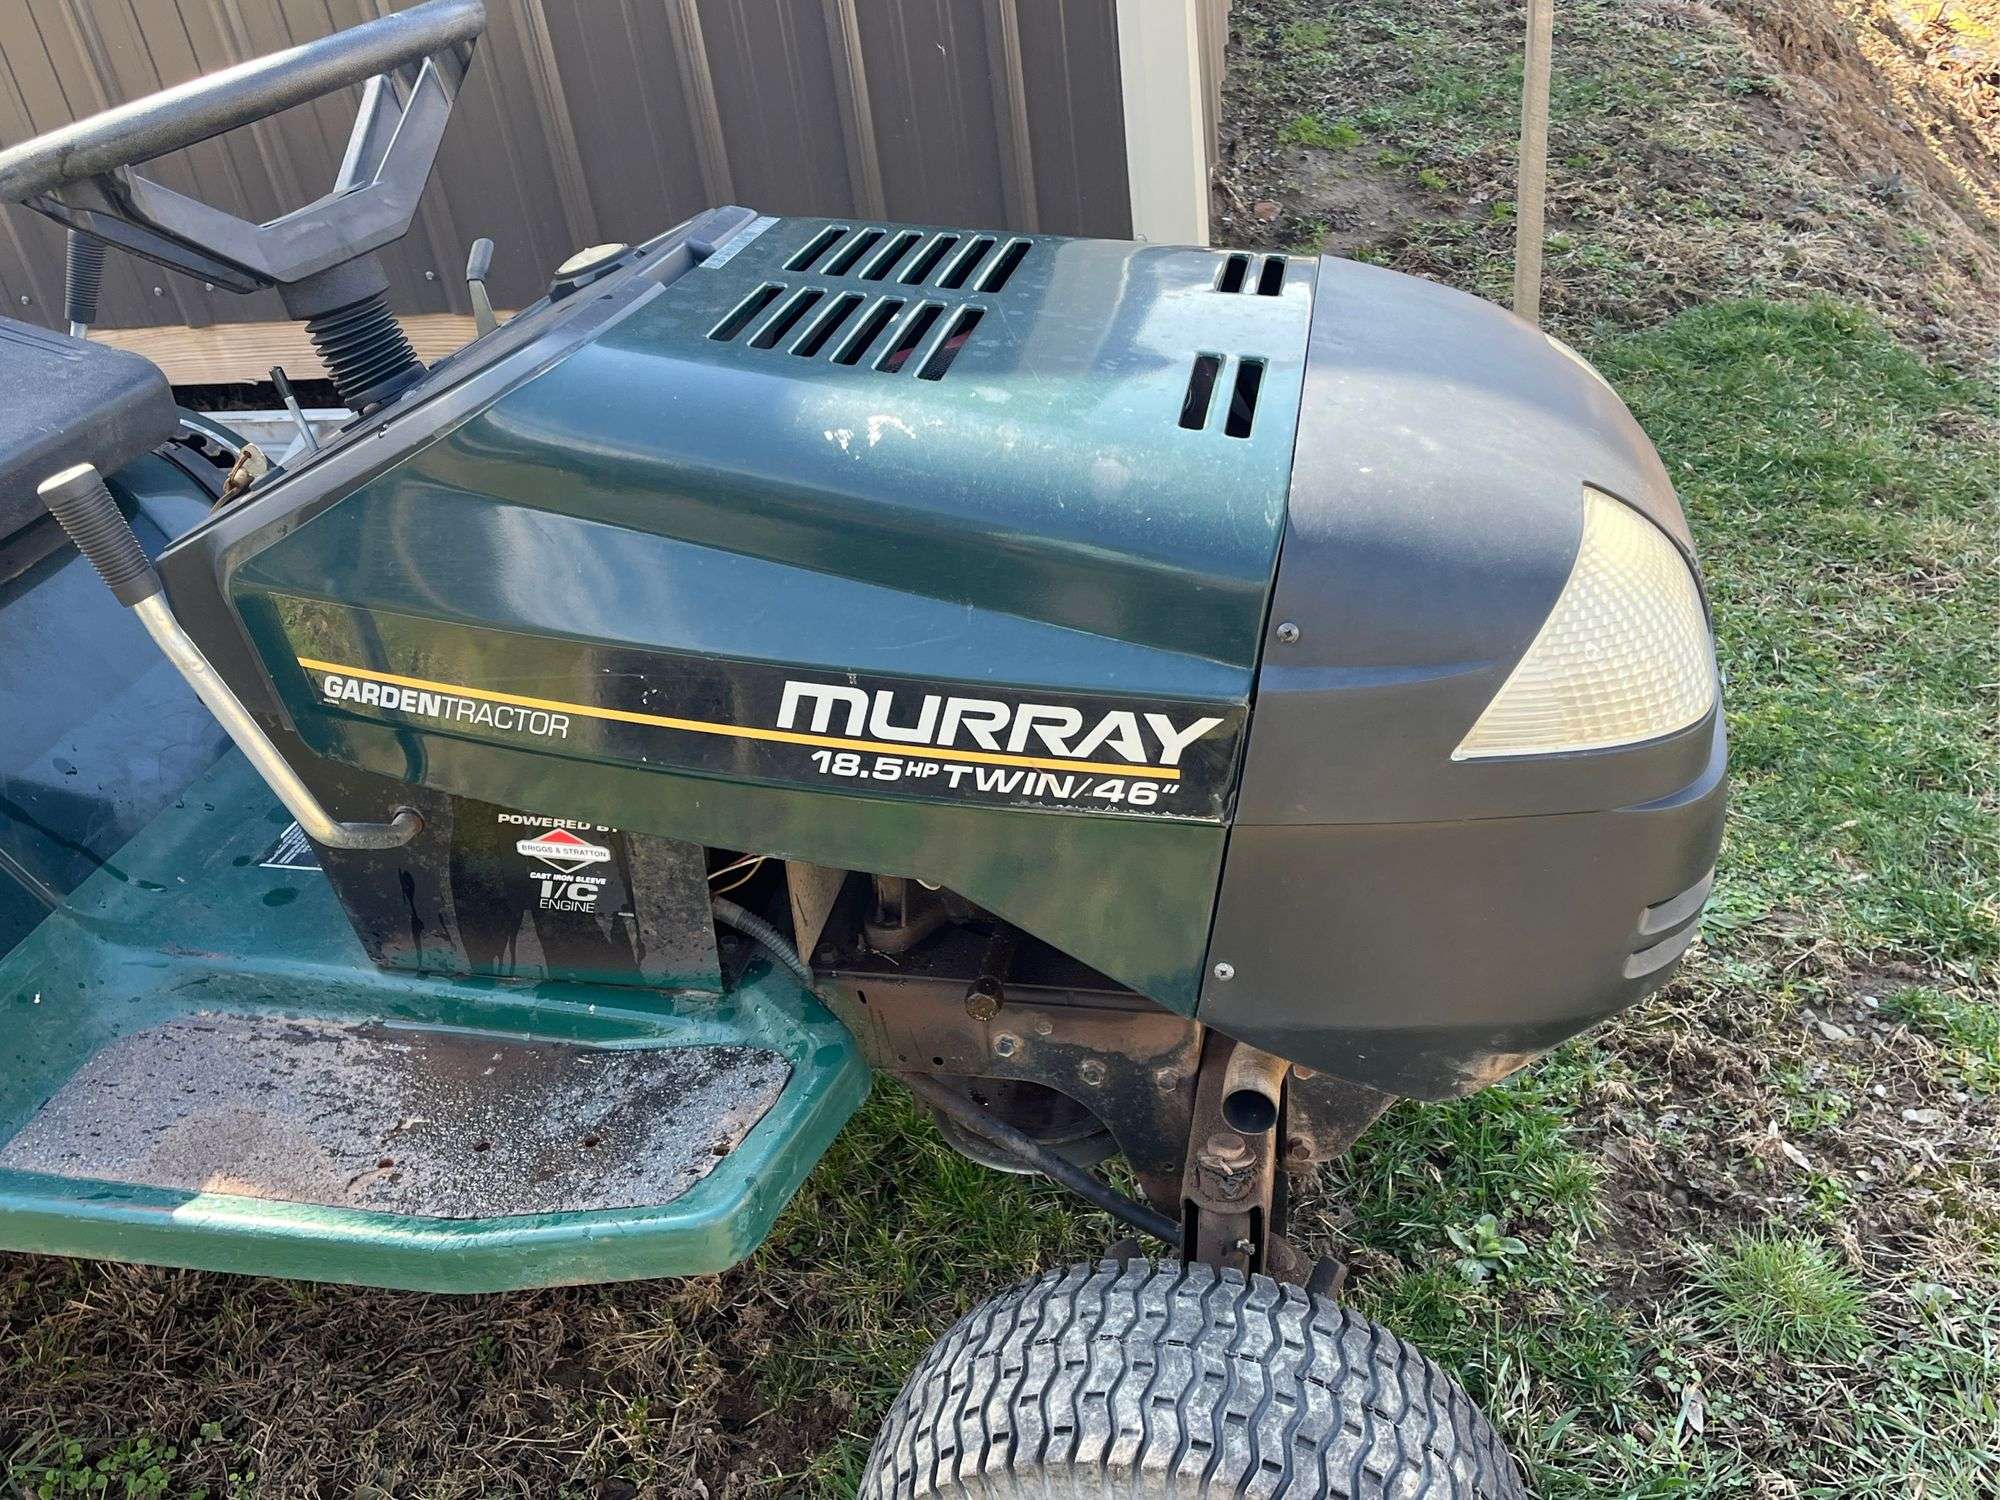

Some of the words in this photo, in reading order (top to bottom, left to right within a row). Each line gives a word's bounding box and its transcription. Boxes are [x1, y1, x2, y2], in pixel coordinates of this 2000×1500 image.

[776, 680, 1224, 765] MURRAY
[498, 813, 591, 831] POWERED
[521, 844, 554, 854] BRIGGS
[562, 847, 607, 858] STRATTON
[529, 872, 552, 880] CAST
[552, 874, 574, 882] IRON
[575, 876, 607, 885] SLEEVE
[540, 880, 599, 902] I/C
[539, 898, 596, 914] ENGINE
